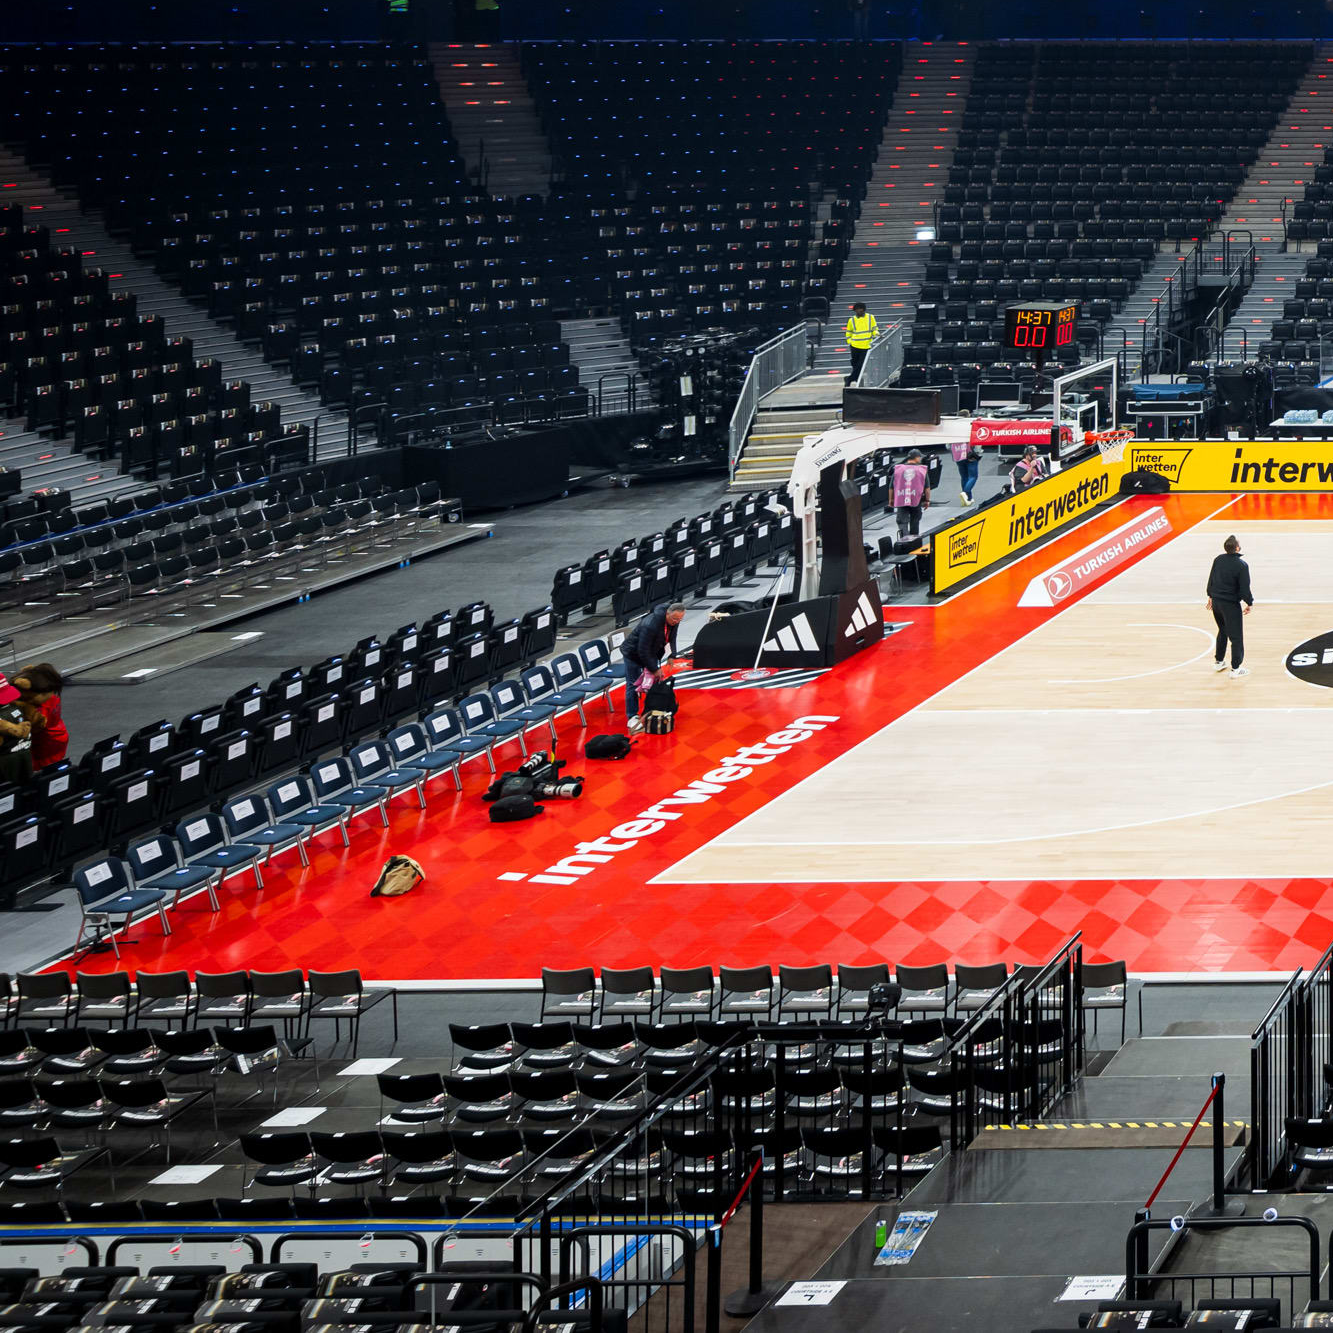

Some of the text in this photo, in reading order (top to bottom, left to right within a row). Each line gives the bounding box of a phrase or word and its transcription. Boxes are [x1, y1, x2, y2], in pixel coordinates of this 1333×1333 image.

[1016, 310, 1052, 325] 14:37
[1014, 326, 1046, 347] 0.0
[992, 428, 1022, 436] TURKISH
[815, 446, 842, 468] SPALDING
[1135, 453, 1164, 465] inter
[1136, 461, 1178, 474] wetten
[1008, 472, 1110, 548] interwetten
[951, 533, 969, 553] inter
[952, 542, 978, 563] wetten
[1074, 513, 1170, 580] TURKISH AIRLINES
[497, 713, 840, 885] interwetten
